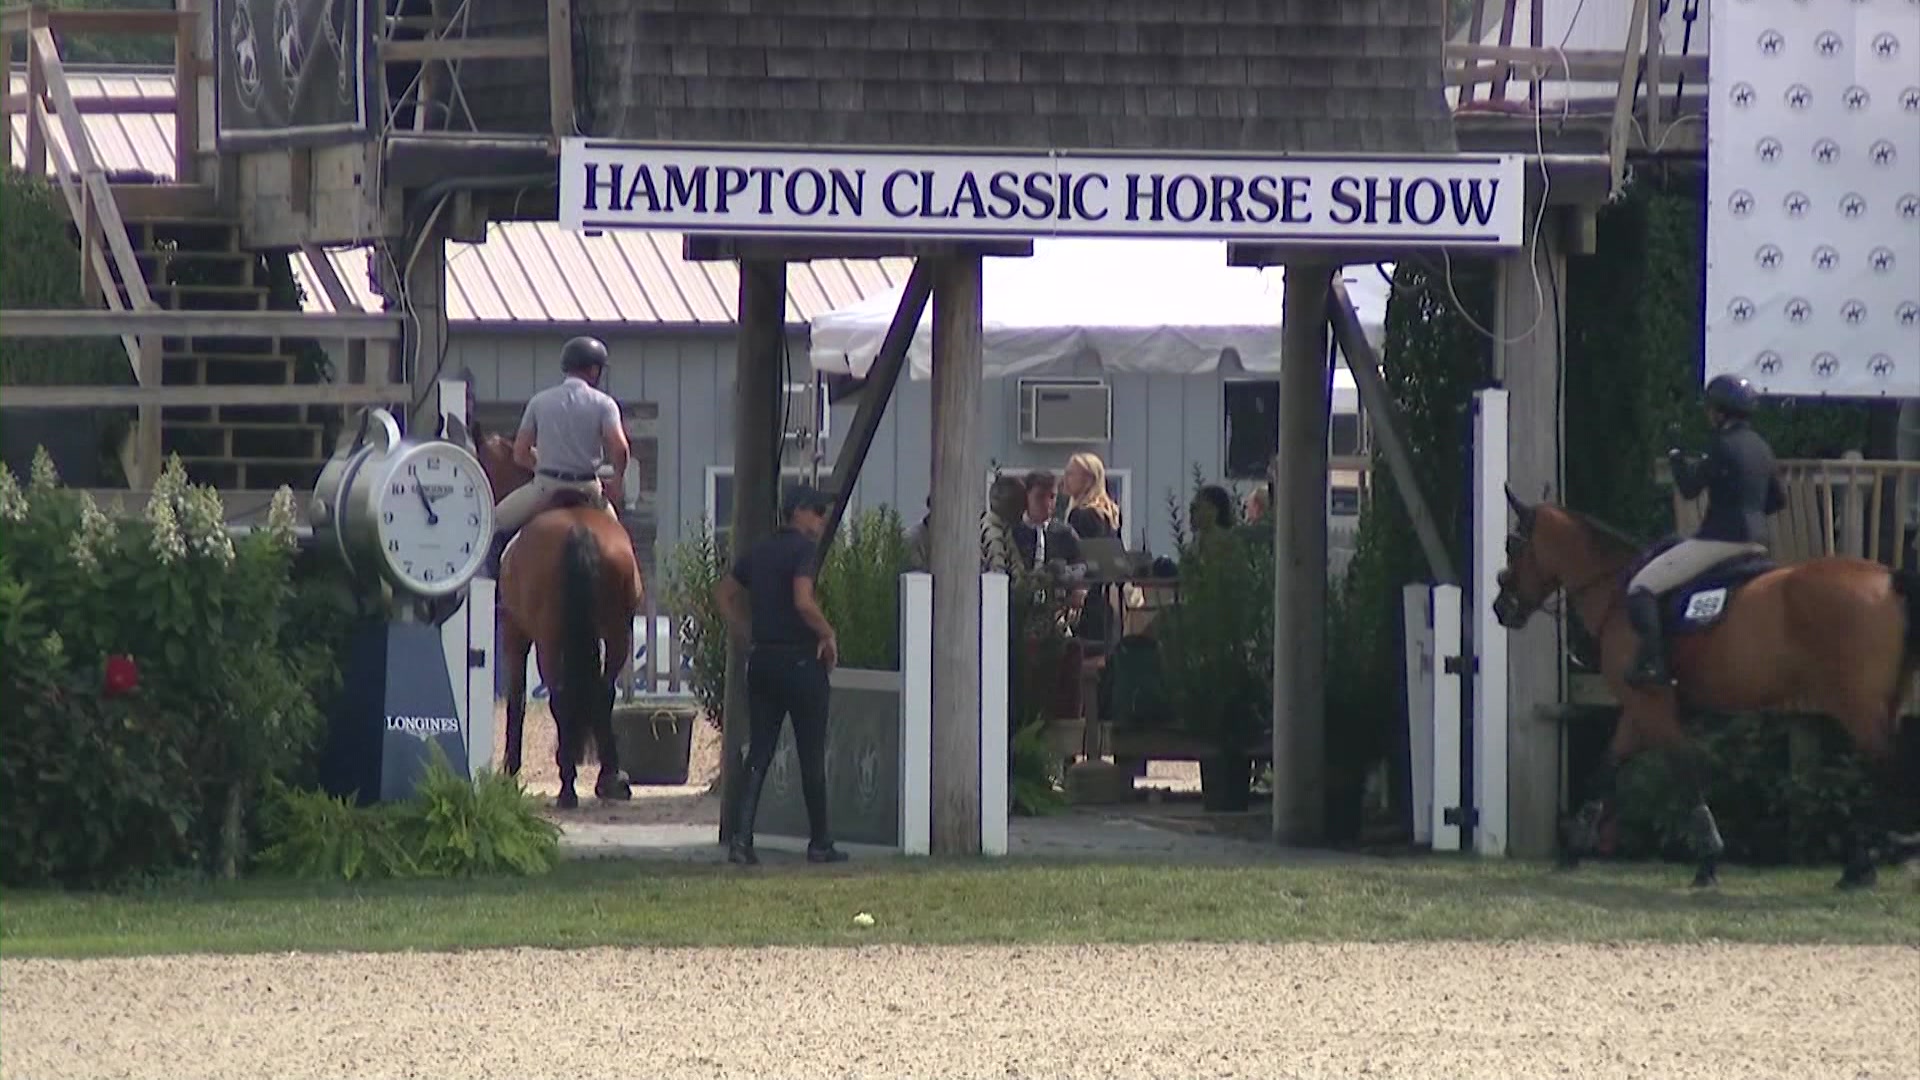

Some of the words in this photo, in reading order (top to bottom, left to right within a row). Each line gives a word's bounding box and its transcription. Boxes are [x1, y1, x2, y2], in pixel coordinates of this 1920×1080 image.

[583, 163, 865, 217] HAMPTON
[882, 169, 1109, 221] CLASSIC
[1125, 173, 1312, 224] HORSE
[1329, 175, 1499, 226] SHOW
[392, 484, 404, 495] 10
[384, 511, 393, 524] 9
[388, 540, 399, 552] 8
[460, 542, 469, 554] 4
[404, 562, 414, 574] 7
[445, 562, 455, 574] 5
[424, 570, 433, 581] 6
[386, 716, 458, 732] LONGINES
